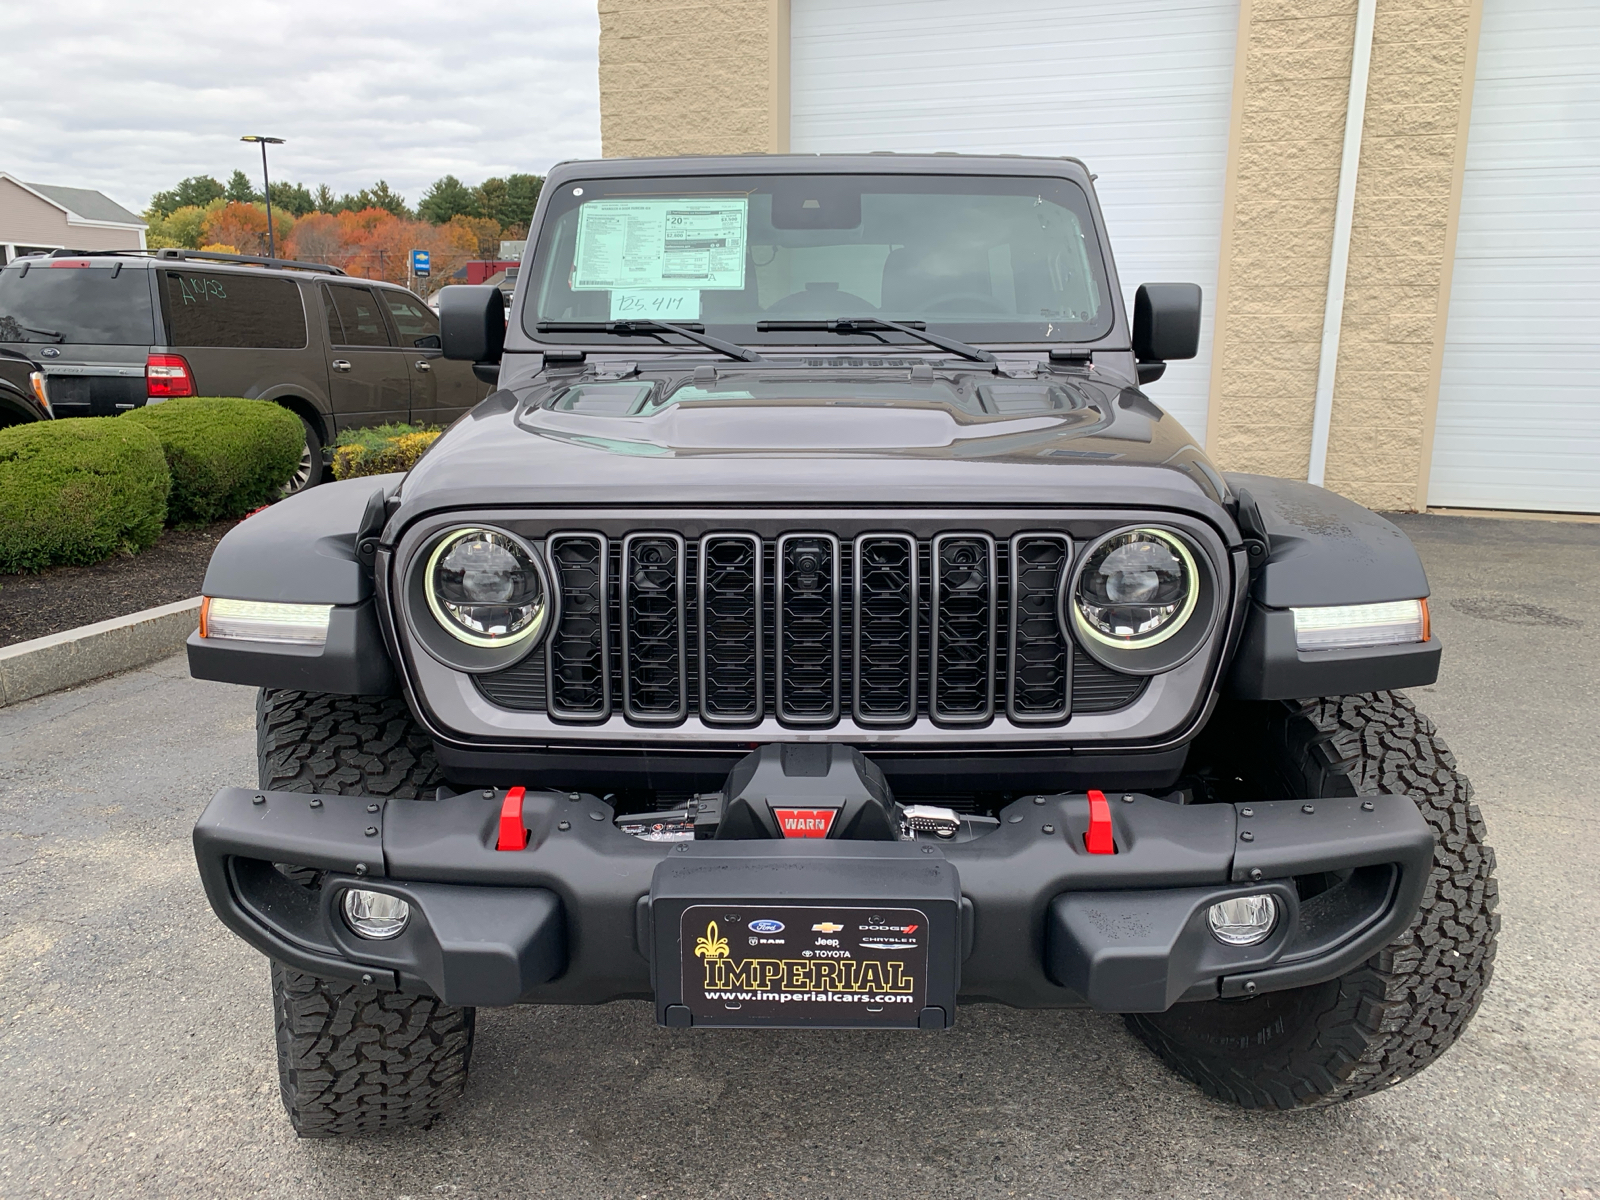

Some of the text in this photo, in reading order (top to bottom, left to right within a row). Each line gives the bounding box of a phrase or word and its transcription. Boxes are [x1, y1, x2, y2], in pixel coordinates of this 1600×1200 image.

[671, 217, 683, 225] 20
[707, 273, 717, 281] A
[785, 818, 825, 830] WARN
[815, 937, 840, 947] Jeep
[814, 950, 851, 958] TOYOTA
[704, 958, 914, 992] IMPERIAL
[704, 990, 914, 1004] www.imperialcars.com
